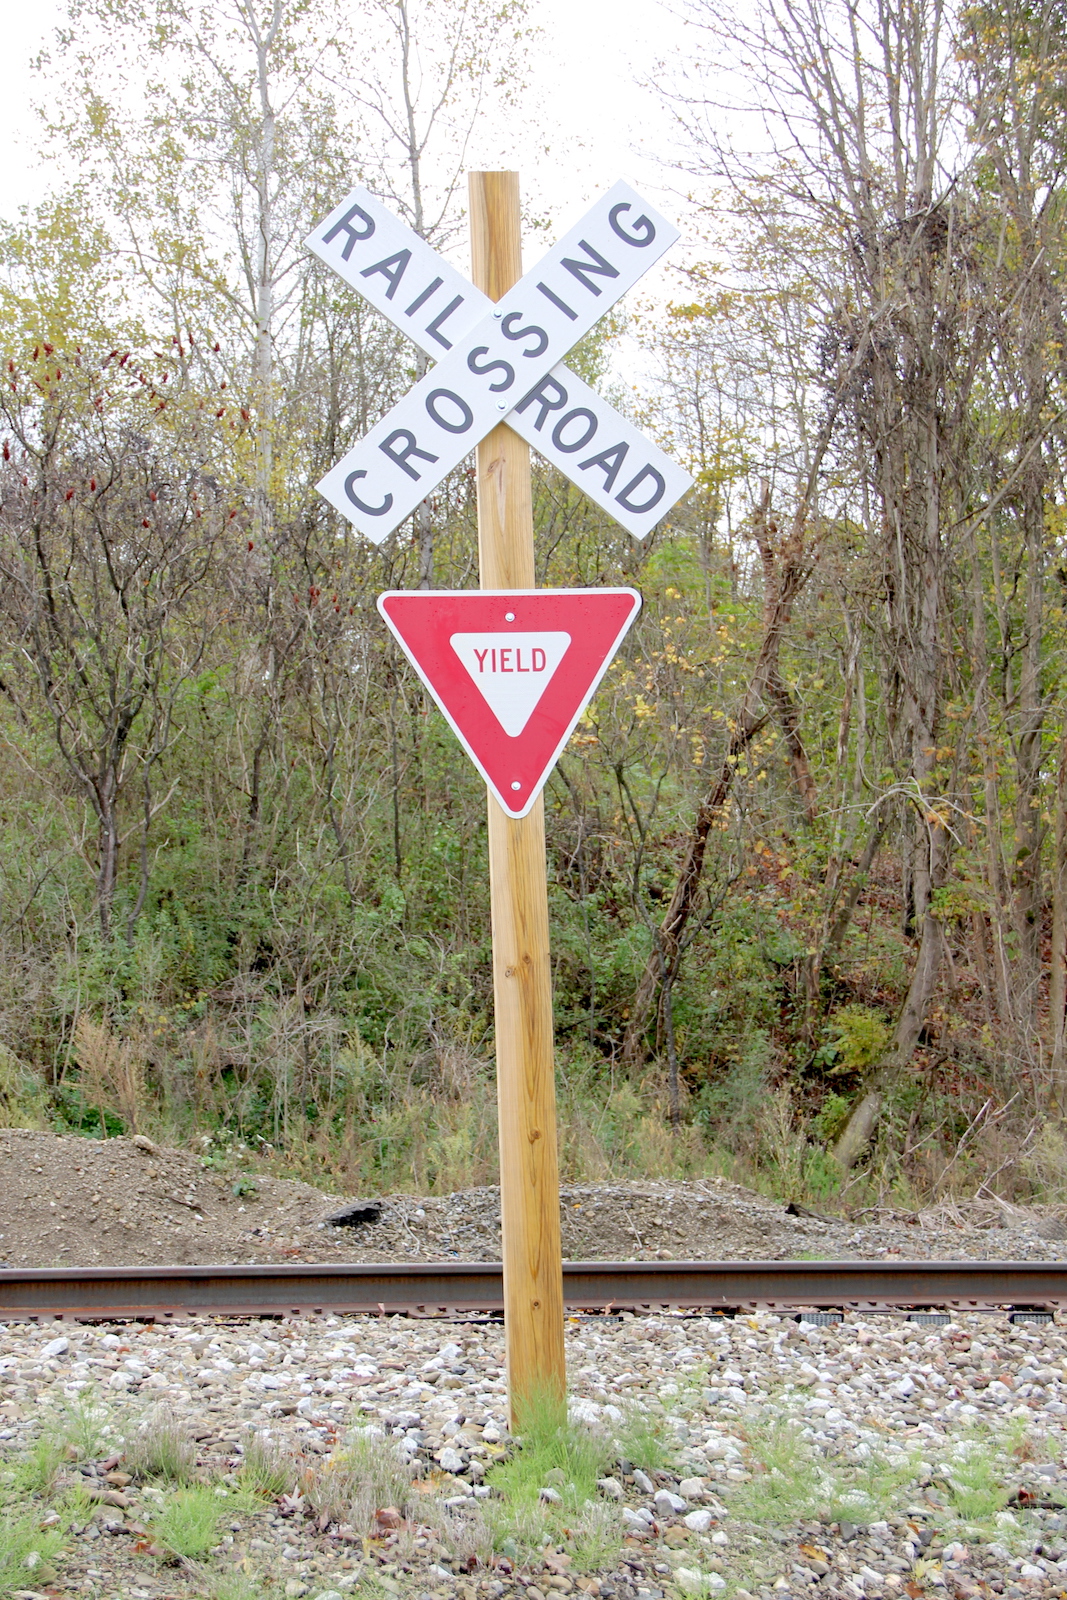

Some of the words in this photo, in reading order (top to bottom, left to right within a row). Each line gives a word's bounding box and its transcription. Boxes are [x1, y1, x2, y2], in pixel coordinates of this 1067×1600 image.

[321, 203, 465, 350] RAIL
[515, 374, 666, 514] ROAD
[344, 202, 656, 517] CROSSING
[473, 648, 547, 673] YIELD
